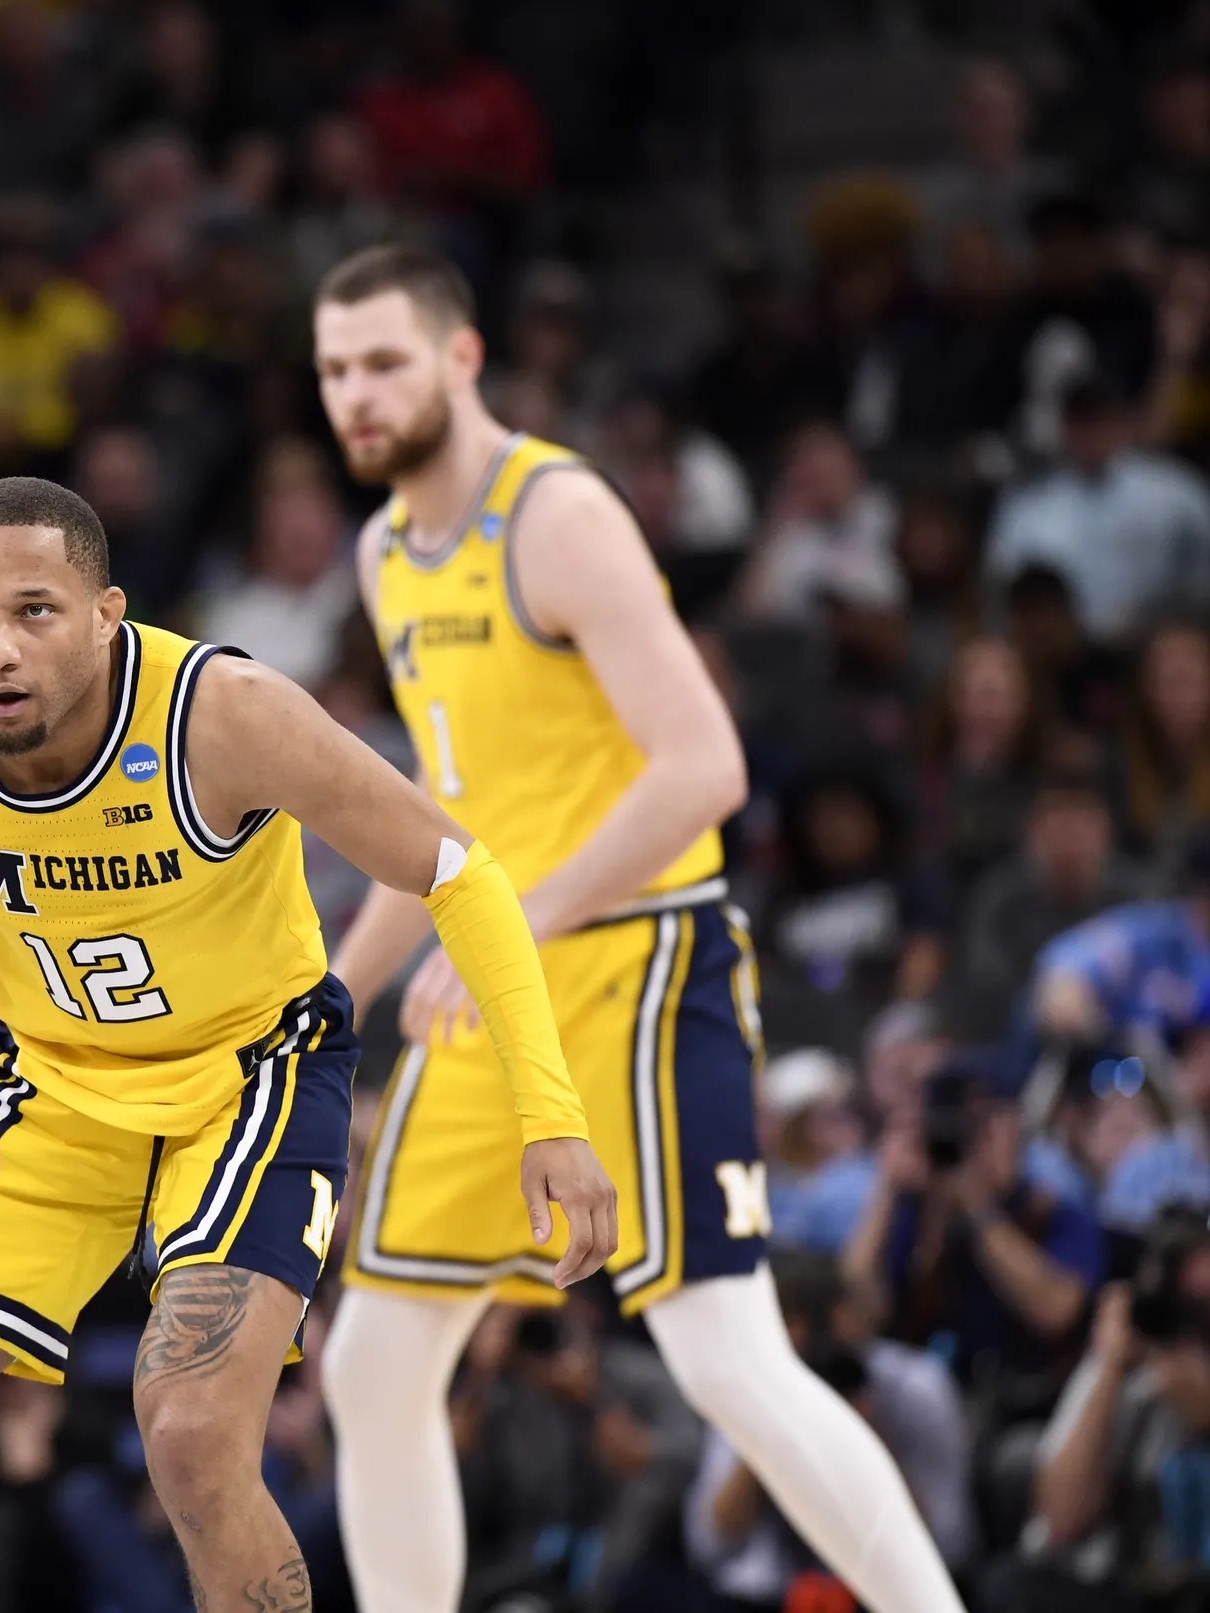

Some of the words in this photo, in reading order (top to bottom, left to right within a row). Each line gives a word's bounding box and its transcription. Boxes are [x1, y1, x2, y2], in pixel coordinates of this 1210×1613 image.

[126, 760, 158, 774] NCAA
[428, 699, 463, 798] 1
[20, 932, 173, 1024] 12
